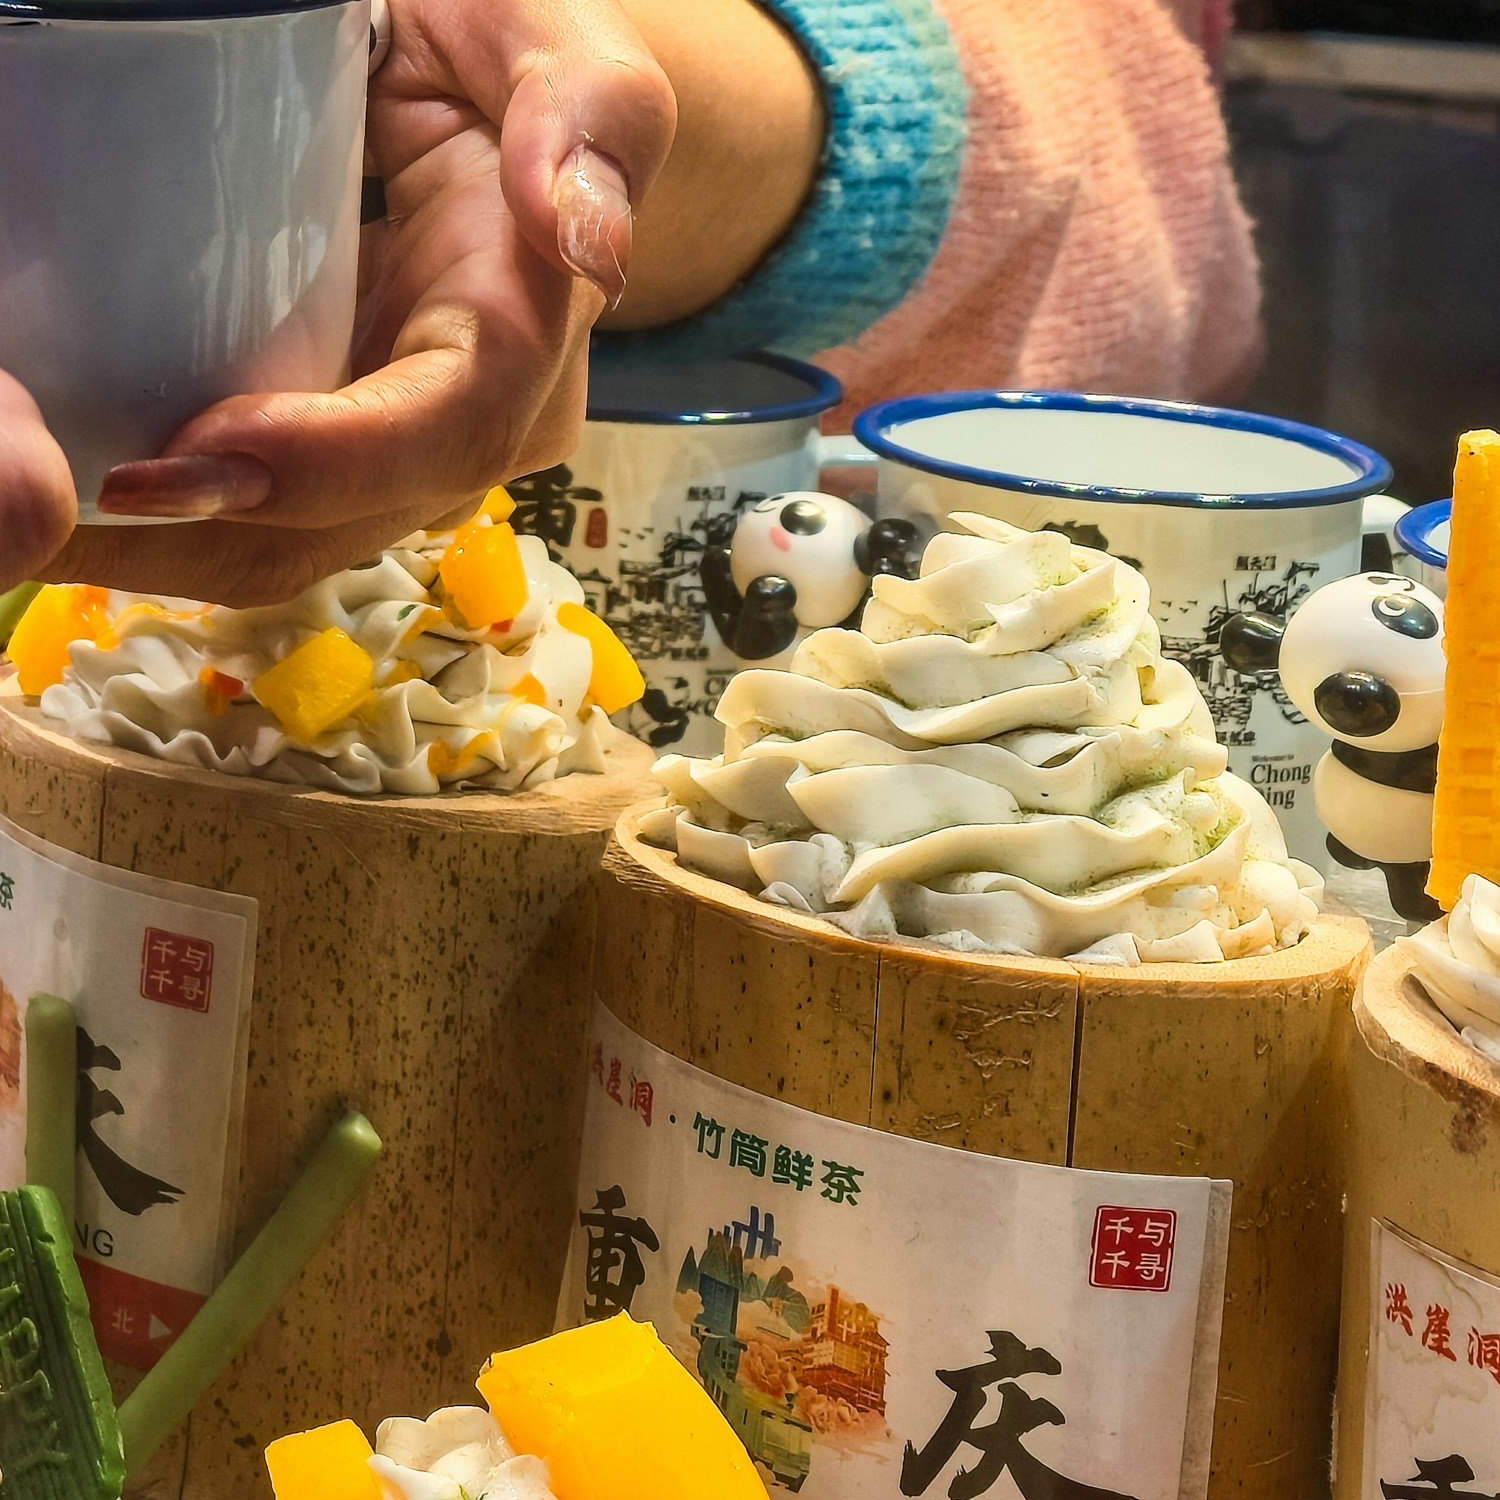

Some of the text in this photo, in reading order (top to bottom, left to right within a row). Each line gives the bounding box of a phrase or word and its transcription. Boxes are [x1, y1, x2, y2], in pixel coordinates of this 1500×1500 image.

[1250, 763, 1312, 785] Chong
[1259, 786, 1296, 810] ing
[691, 1110, 866, 1207] 竹筒鲜茶
[75, 1221, 115, 1258] NG
[112, 1308, 136, 1335] 北
